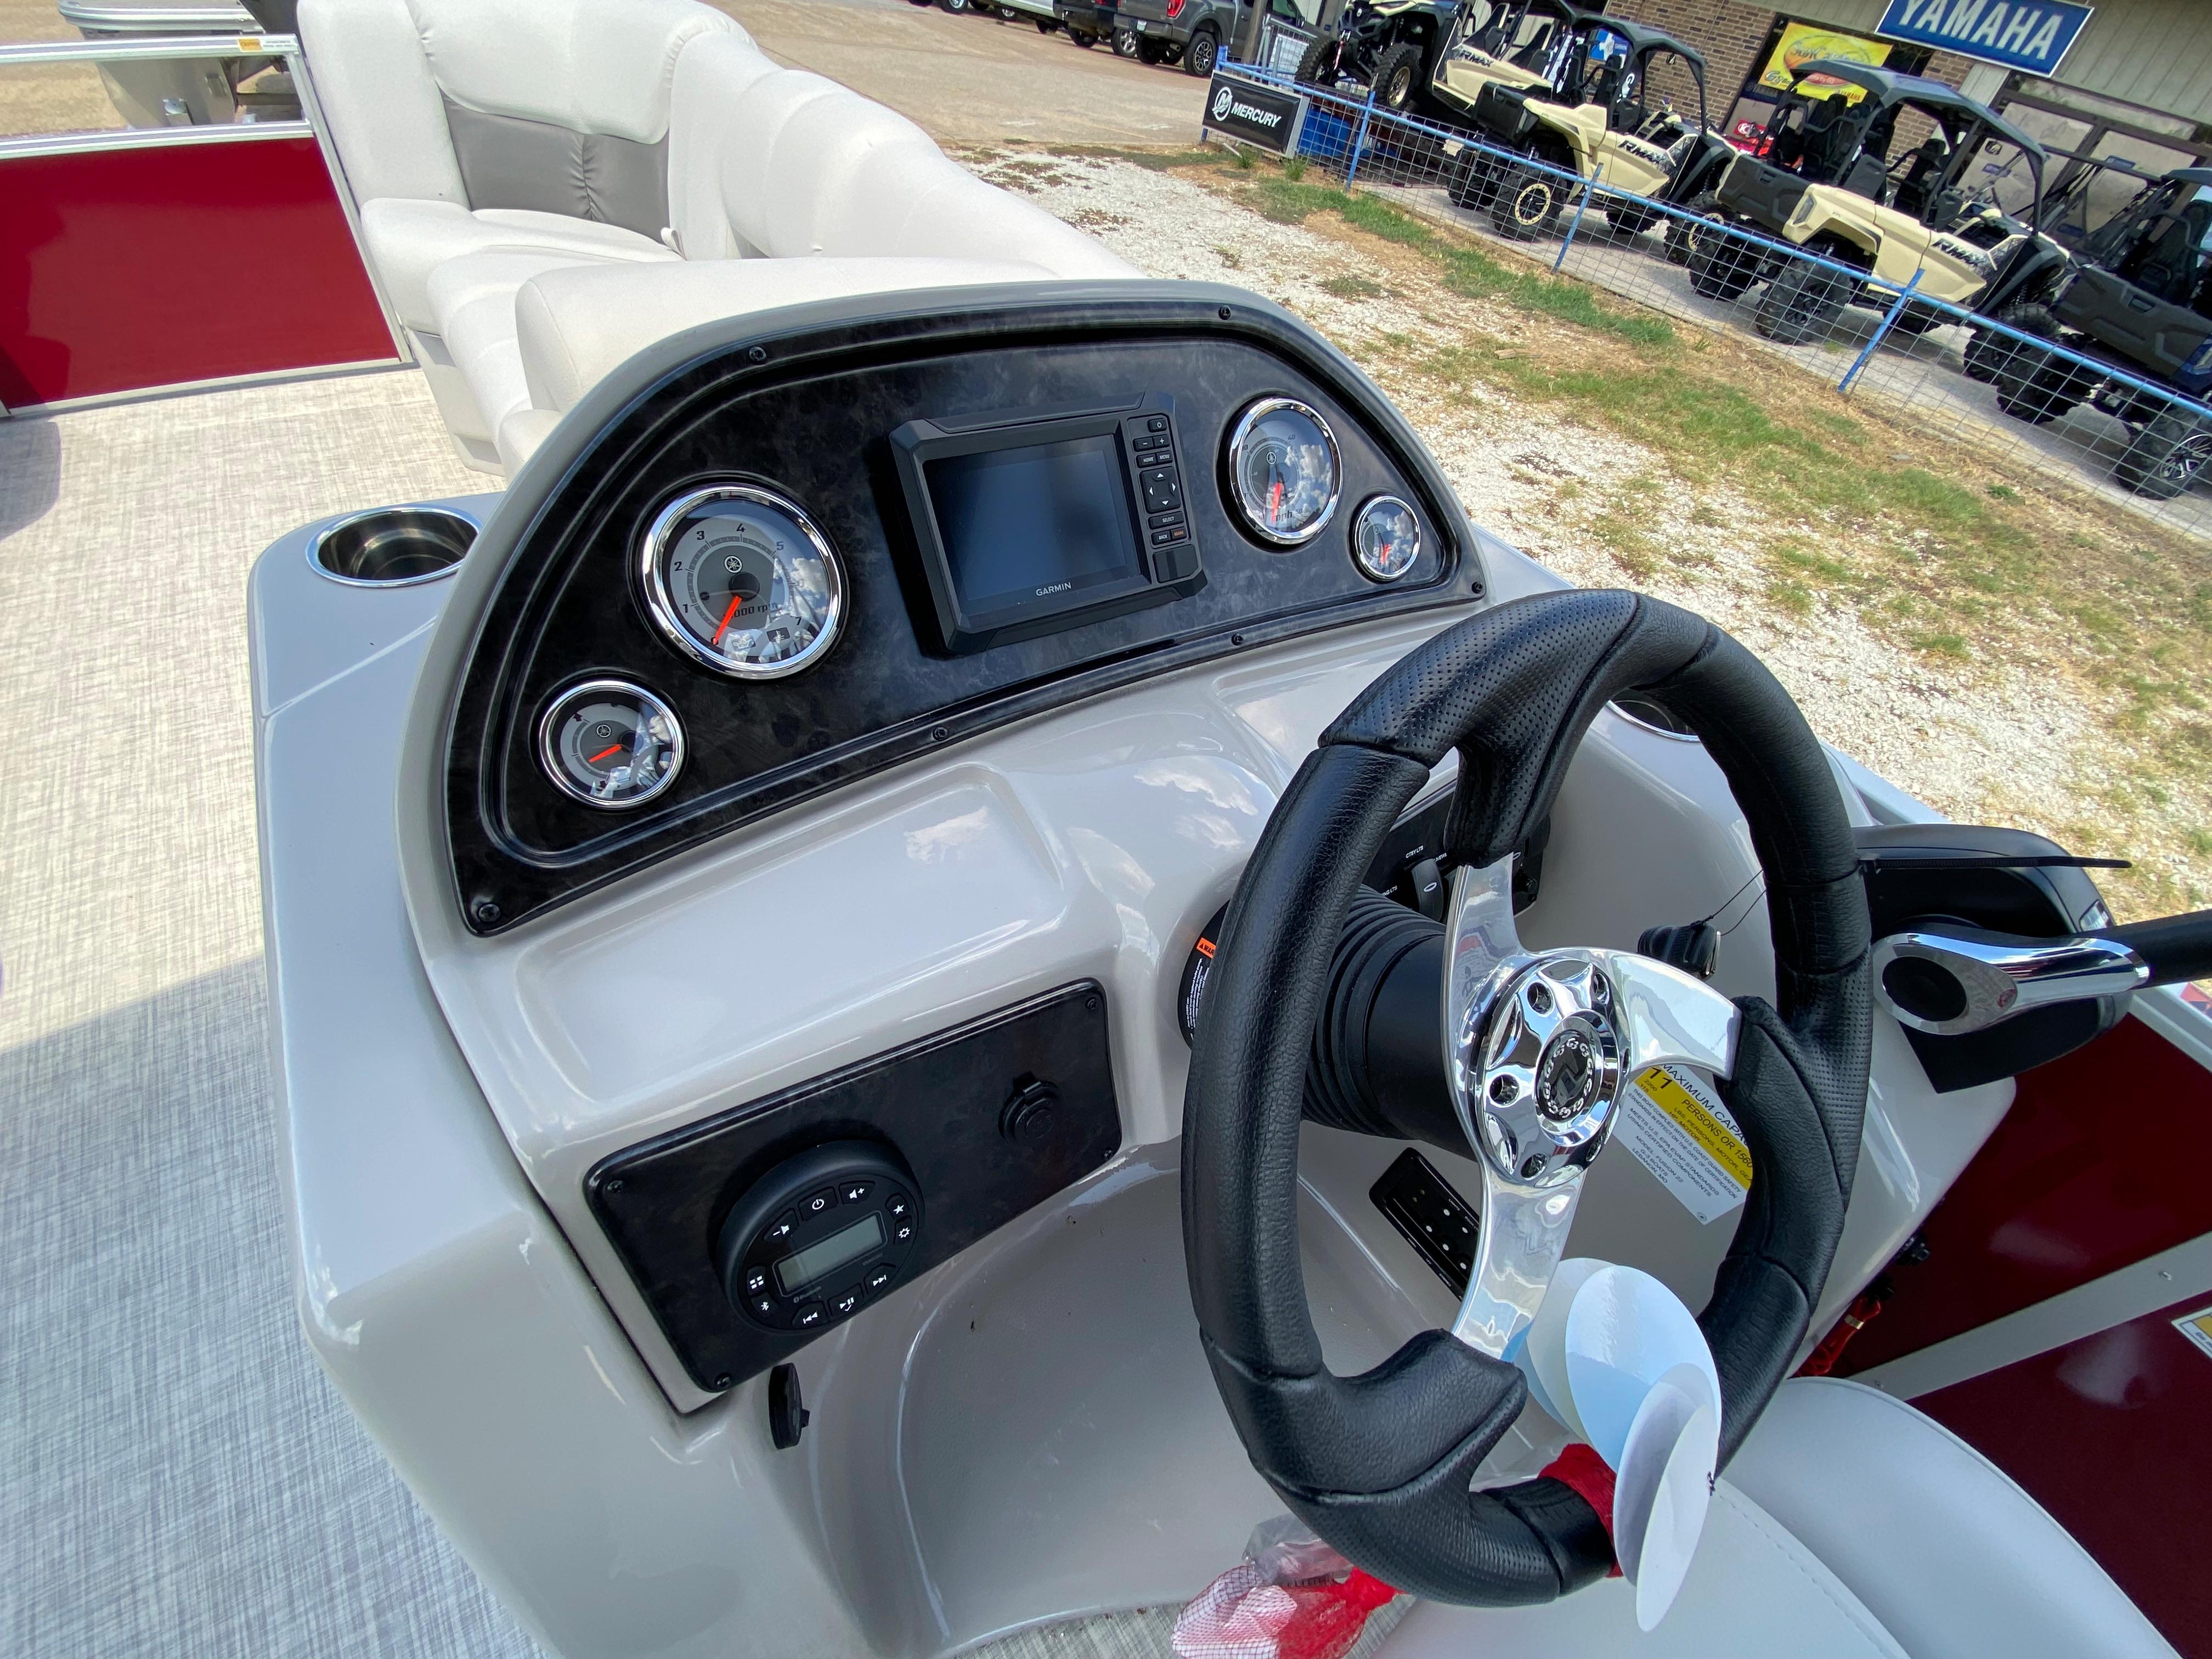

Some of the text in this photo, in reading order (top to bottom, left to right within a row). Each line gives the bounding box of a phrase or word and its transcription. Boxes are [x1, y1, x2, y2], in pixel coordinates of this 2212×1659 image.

[1899, 0, 2063, 60] YAMAHA
[1231, 102, 1282, 128] MERCURY
[696, 531, 705, 540] 3
[736, 523, 746, 533] 4
[776, 541, 785, 551] 5
[674, 561, 683, 572] 2
[1036, 582, 1071, 596] GARMIN
[682, 604, 689, 613] 1
[795, 617, 802, 626] 7
[1644, 1079, 1657, 1091] 2200
[1663, 1064, 1715, 1111] MAXIMUM
[1679, 1121, 1700, 1142] MOTOR
[1681, 1099, 1722, 1137] PERSONS
[1720, 1136, 1735, 1150] OR
[1628, 1092, 1652, 1116] STANDARDS
[1687, 1149, 1700, 1161] DATE
[1705, 1167, 1737, 1199] CERTIFICATION
[1629, 1108, 1649, 1126] MEETS
[1659, 1137, 1671, 1148] EPA
[1685, 1162, 1720, 1196] STANDARDS
[1642, 1097, 1654, 1108] BOAT
[1653, 1108, 1674, 1128] COMPLIES
[1674, 1127, 1685, 1139] WITH
[1693, 1146, 1708, 1161] COAST
[1708, 1160, 1724, 1176] GUARD
[1723, 1176, 1742, 1193] SAFETY
[1627, 1114, 1712, 1197] USING CERTIFIED COMPONENTS
[1650, 1158, 1668, 1176] BOATS
[1656, 1155, 1677, 1176] FUSION
[1658, 1173, 1668, 1183] MO
